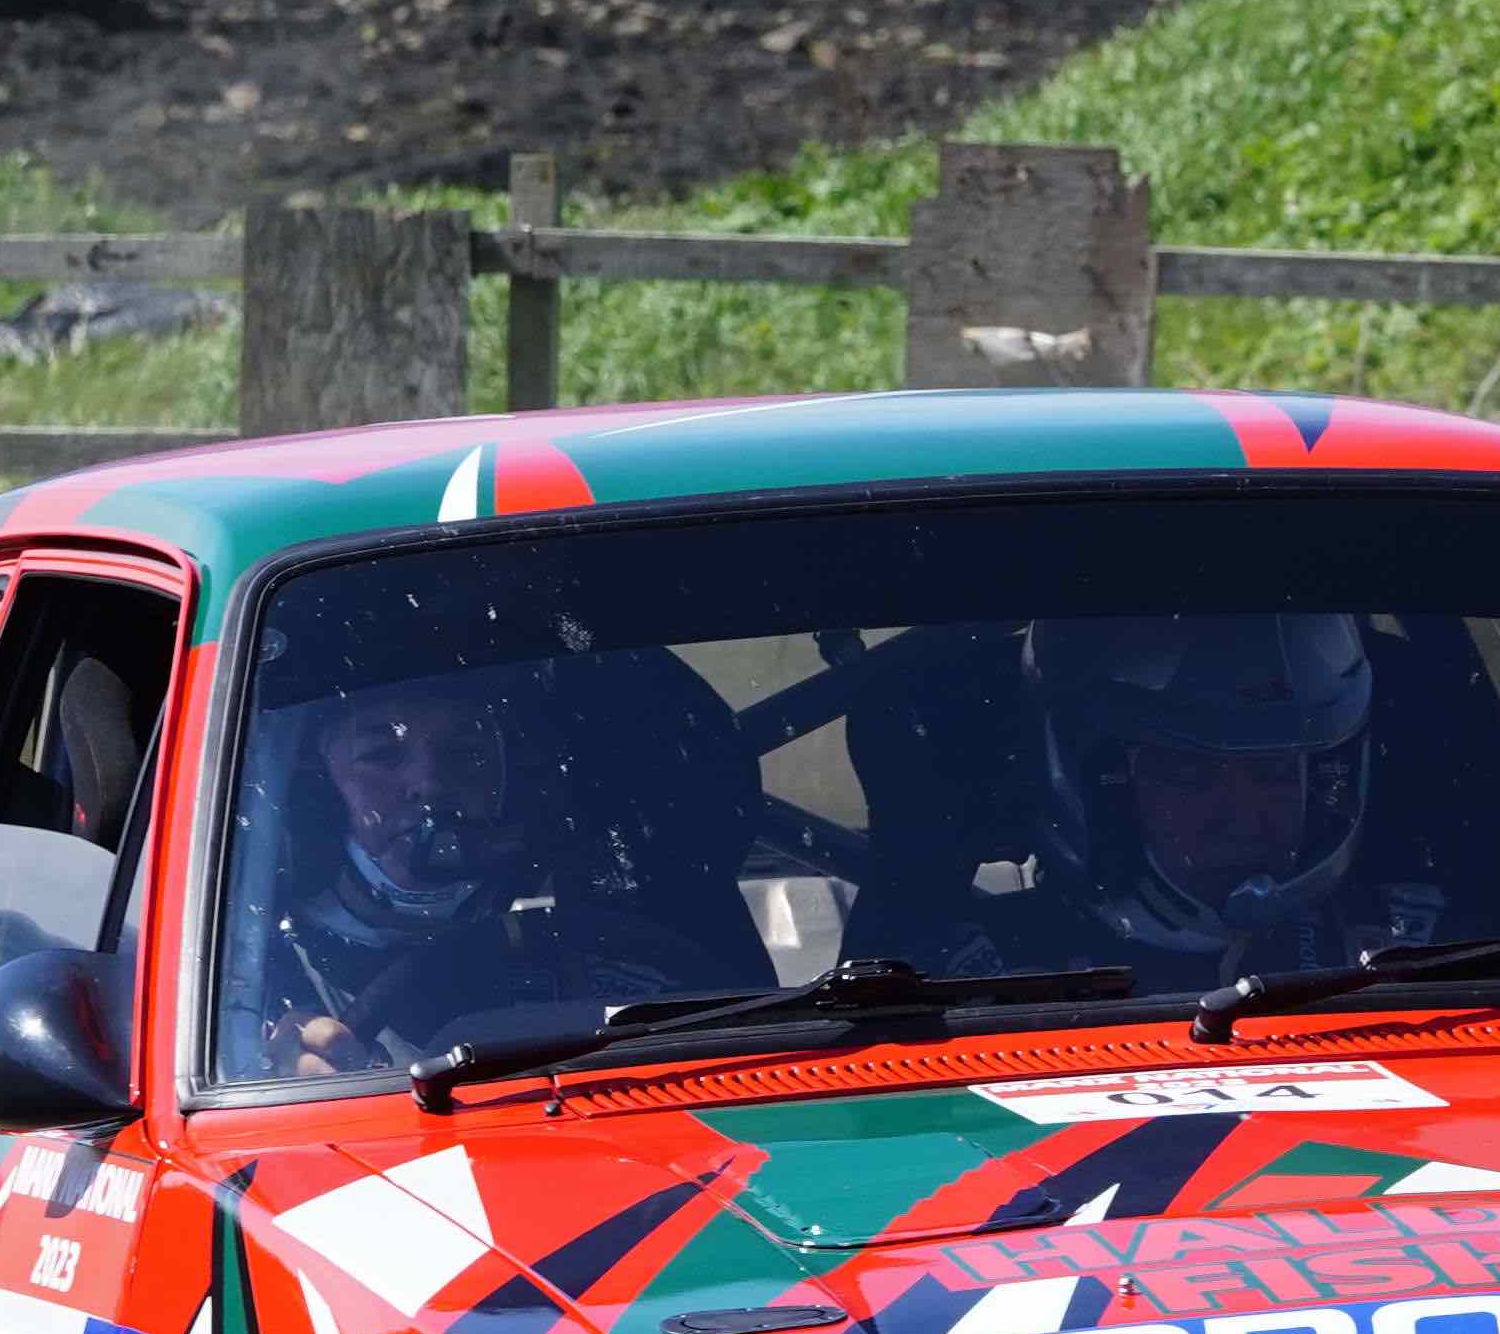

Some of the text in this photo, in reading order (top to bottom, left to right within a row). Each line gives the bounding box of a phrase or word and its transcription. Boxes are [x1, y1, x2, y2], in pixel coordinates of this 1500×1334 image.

[1134, 1064, 1370, 1082] NATIONAL
[1107, 1085, 1324, 1105] 014
[30, 1234, 81, 1293] 2023
